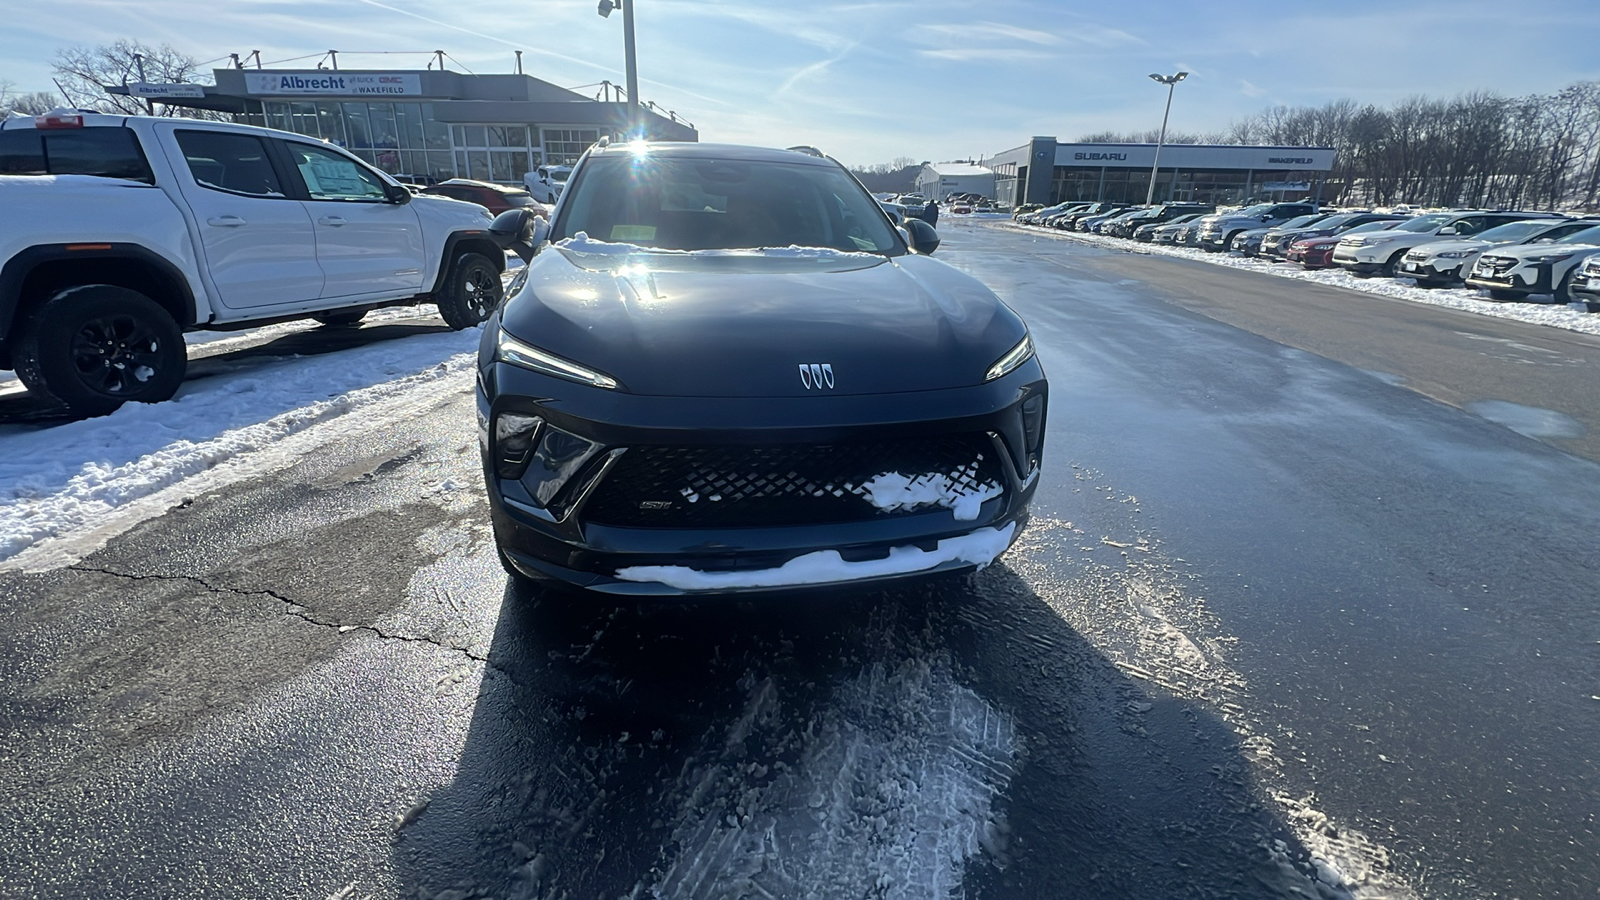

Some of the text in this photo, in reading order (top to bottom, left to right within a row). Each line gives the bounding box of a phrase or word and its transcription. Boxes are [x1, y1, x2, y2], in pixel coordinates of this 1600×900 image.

[280, 76, 346, 89] Albrecht
[378, 76, 403, 84] GMC
[358, 86, 404, 94] WAKEFIELD
[1074, 152, 1127, 161] SUBARU
